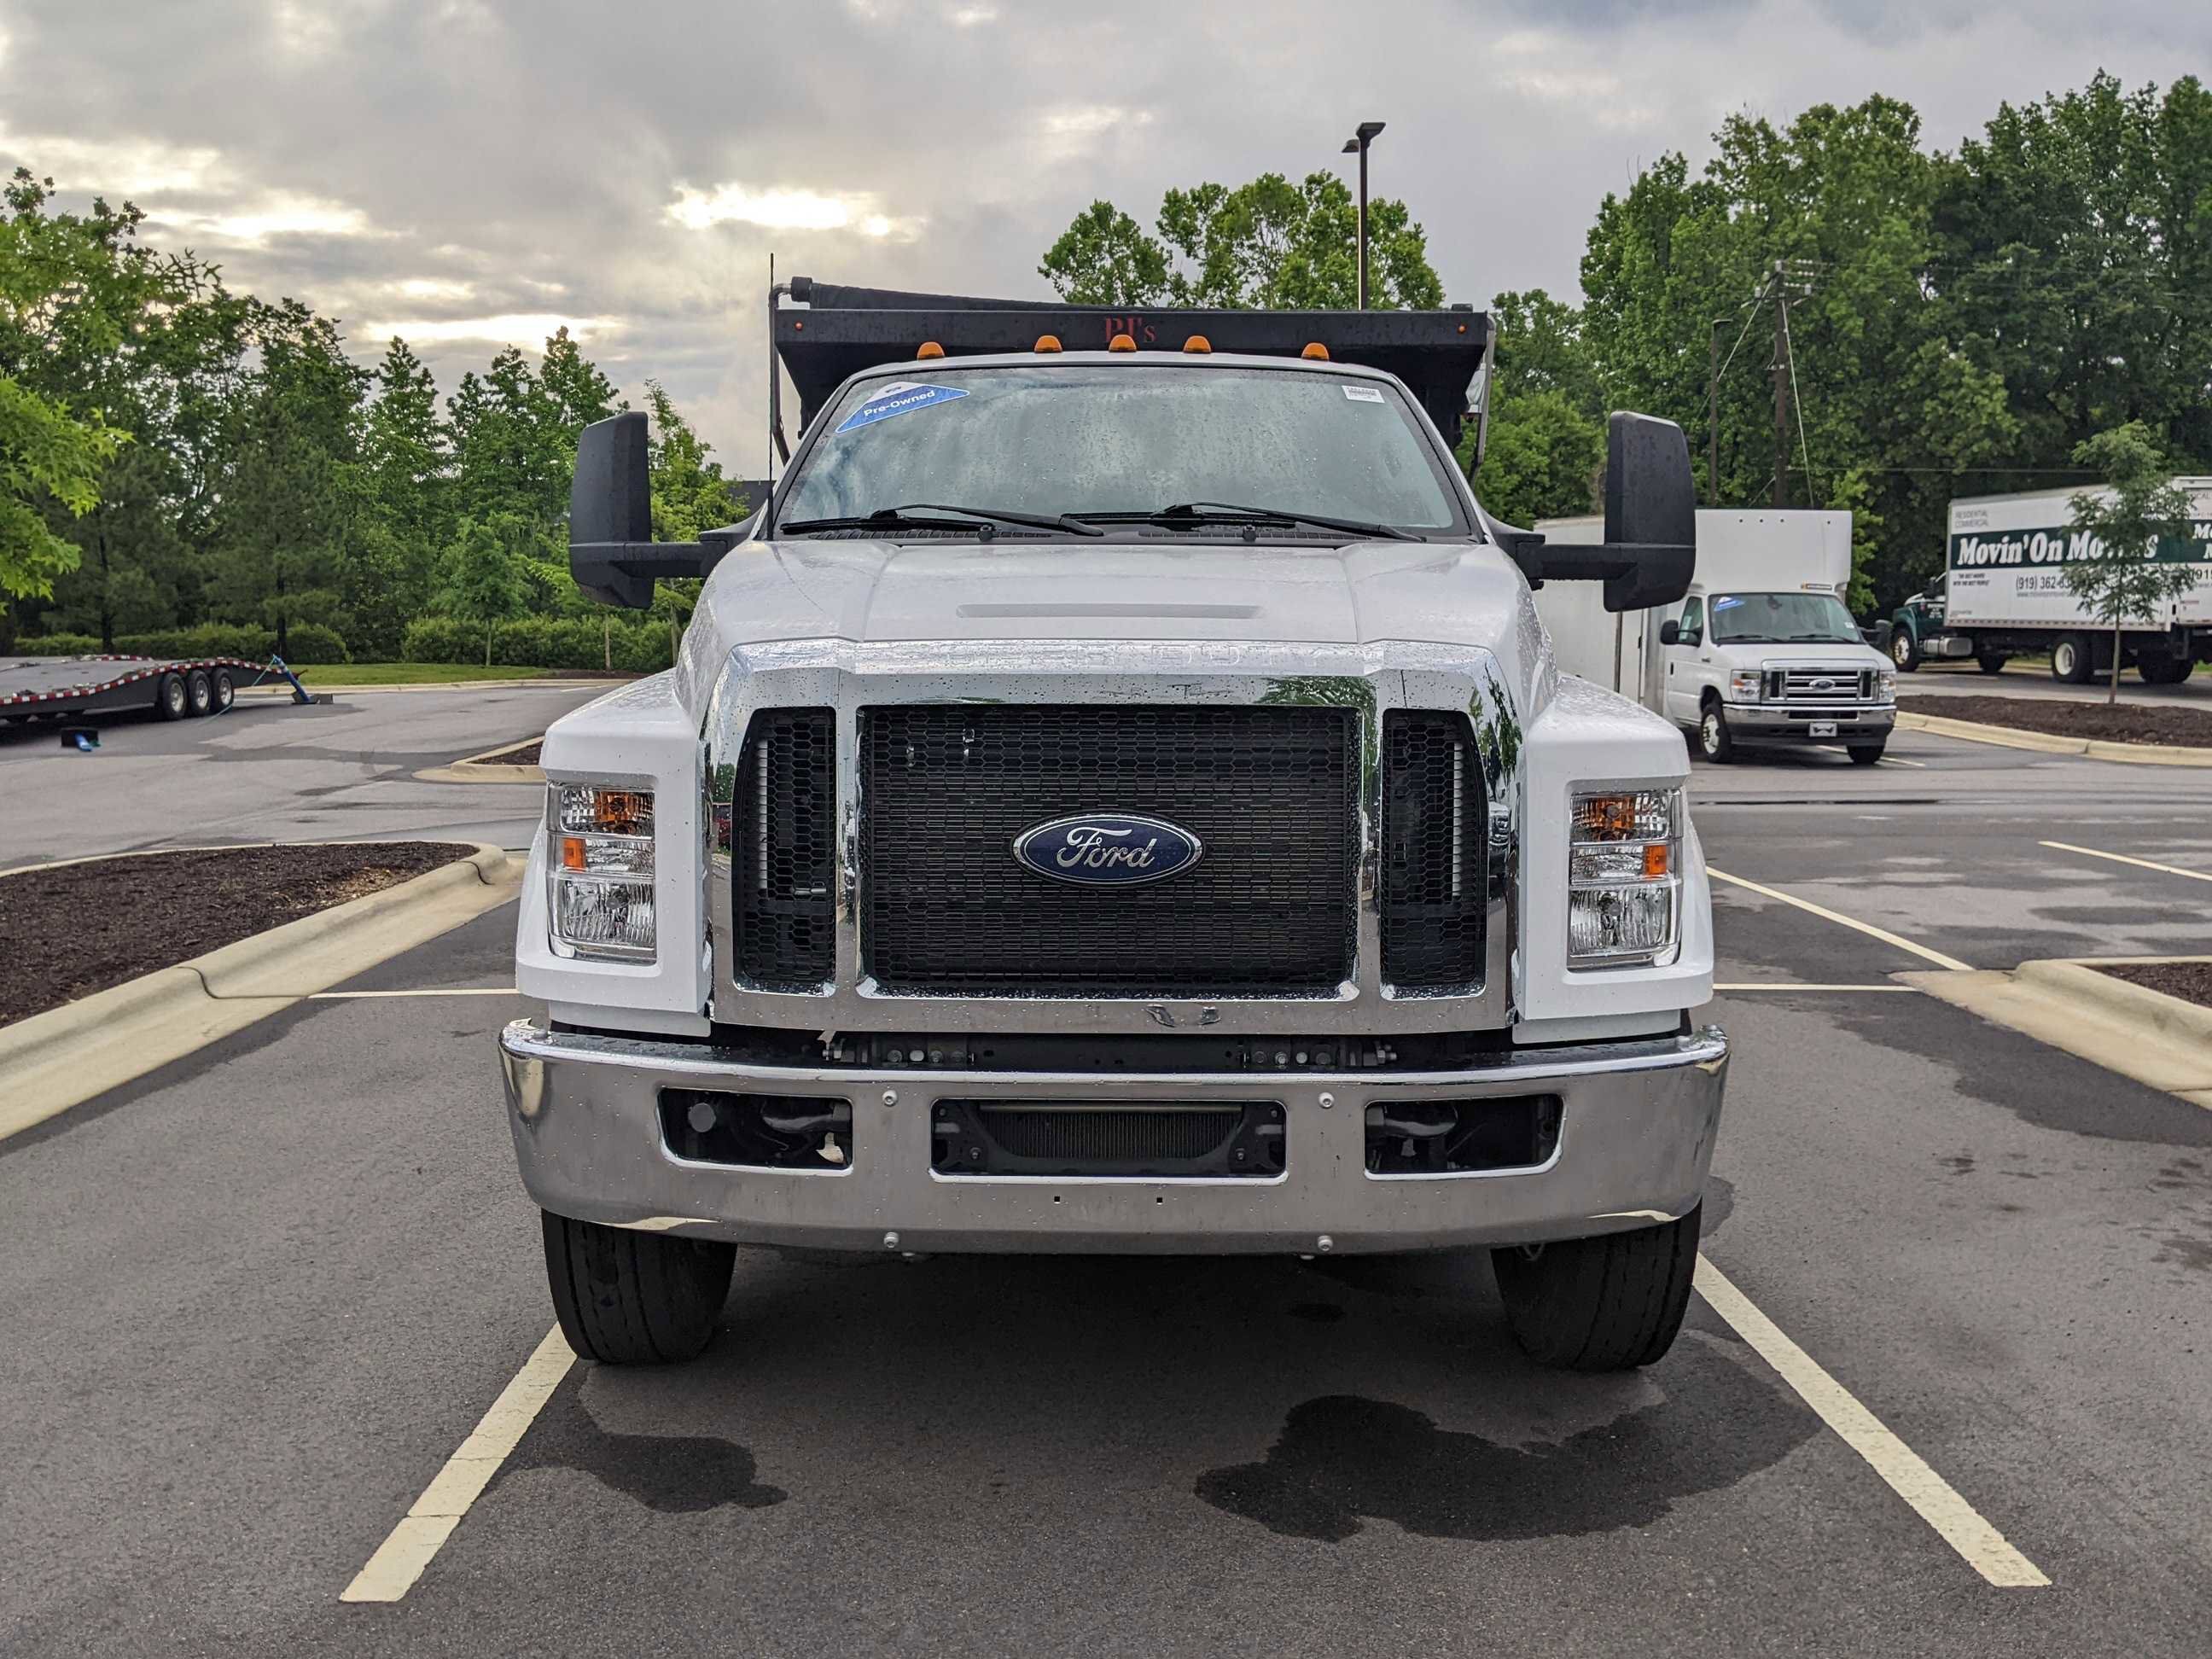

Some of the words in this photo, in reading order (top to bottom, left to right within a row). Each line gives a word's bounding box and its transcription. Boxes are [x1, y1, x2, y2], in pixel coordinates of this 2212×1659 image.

[863, 390, 935, 417] Pre-Owned
[2066, 529, 2159, 561] Mos
[2016, 575, 2038, 591] (919)
[1057, 826, 1157, 868] Ford
